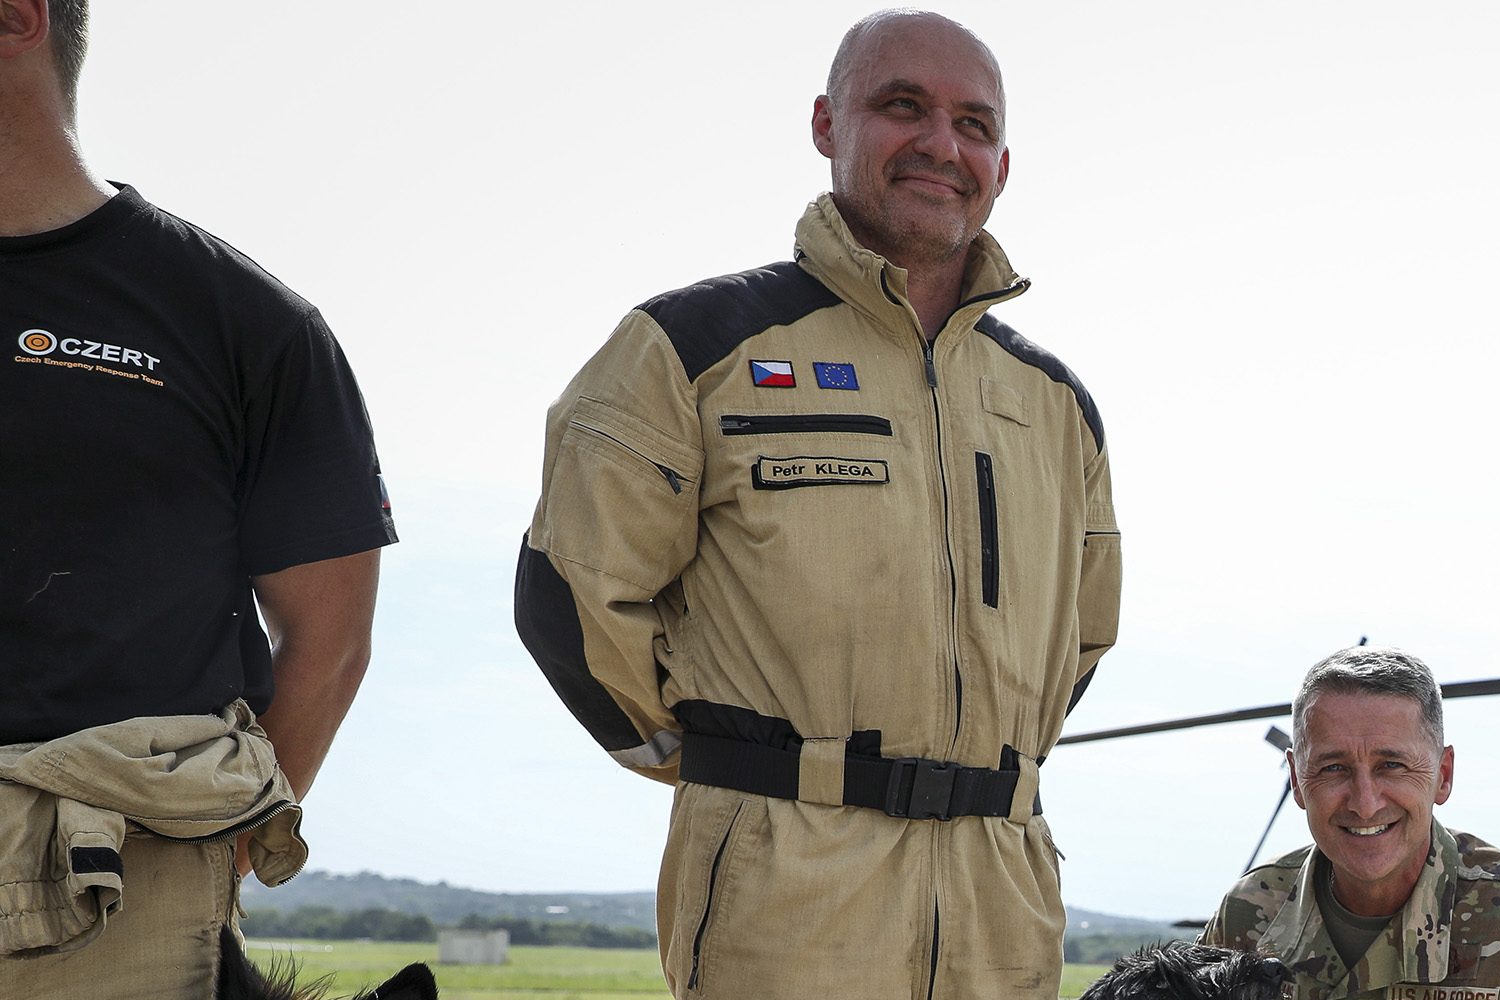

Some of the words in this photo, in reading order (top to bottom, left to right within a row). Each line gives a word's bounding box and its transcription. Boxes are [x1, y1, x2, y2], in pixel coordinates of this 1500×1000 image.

[60, 338, 160, 371] CZERT
[14, 355, 42, 364] Czech
[43, 357, 95, 372] Emergency
[95, 365, 140, 380] Response
[140, 373, 164, 387] Team
[772, 465, 805, 477] Petr
[815, 463, 874, 477] KLEGA
